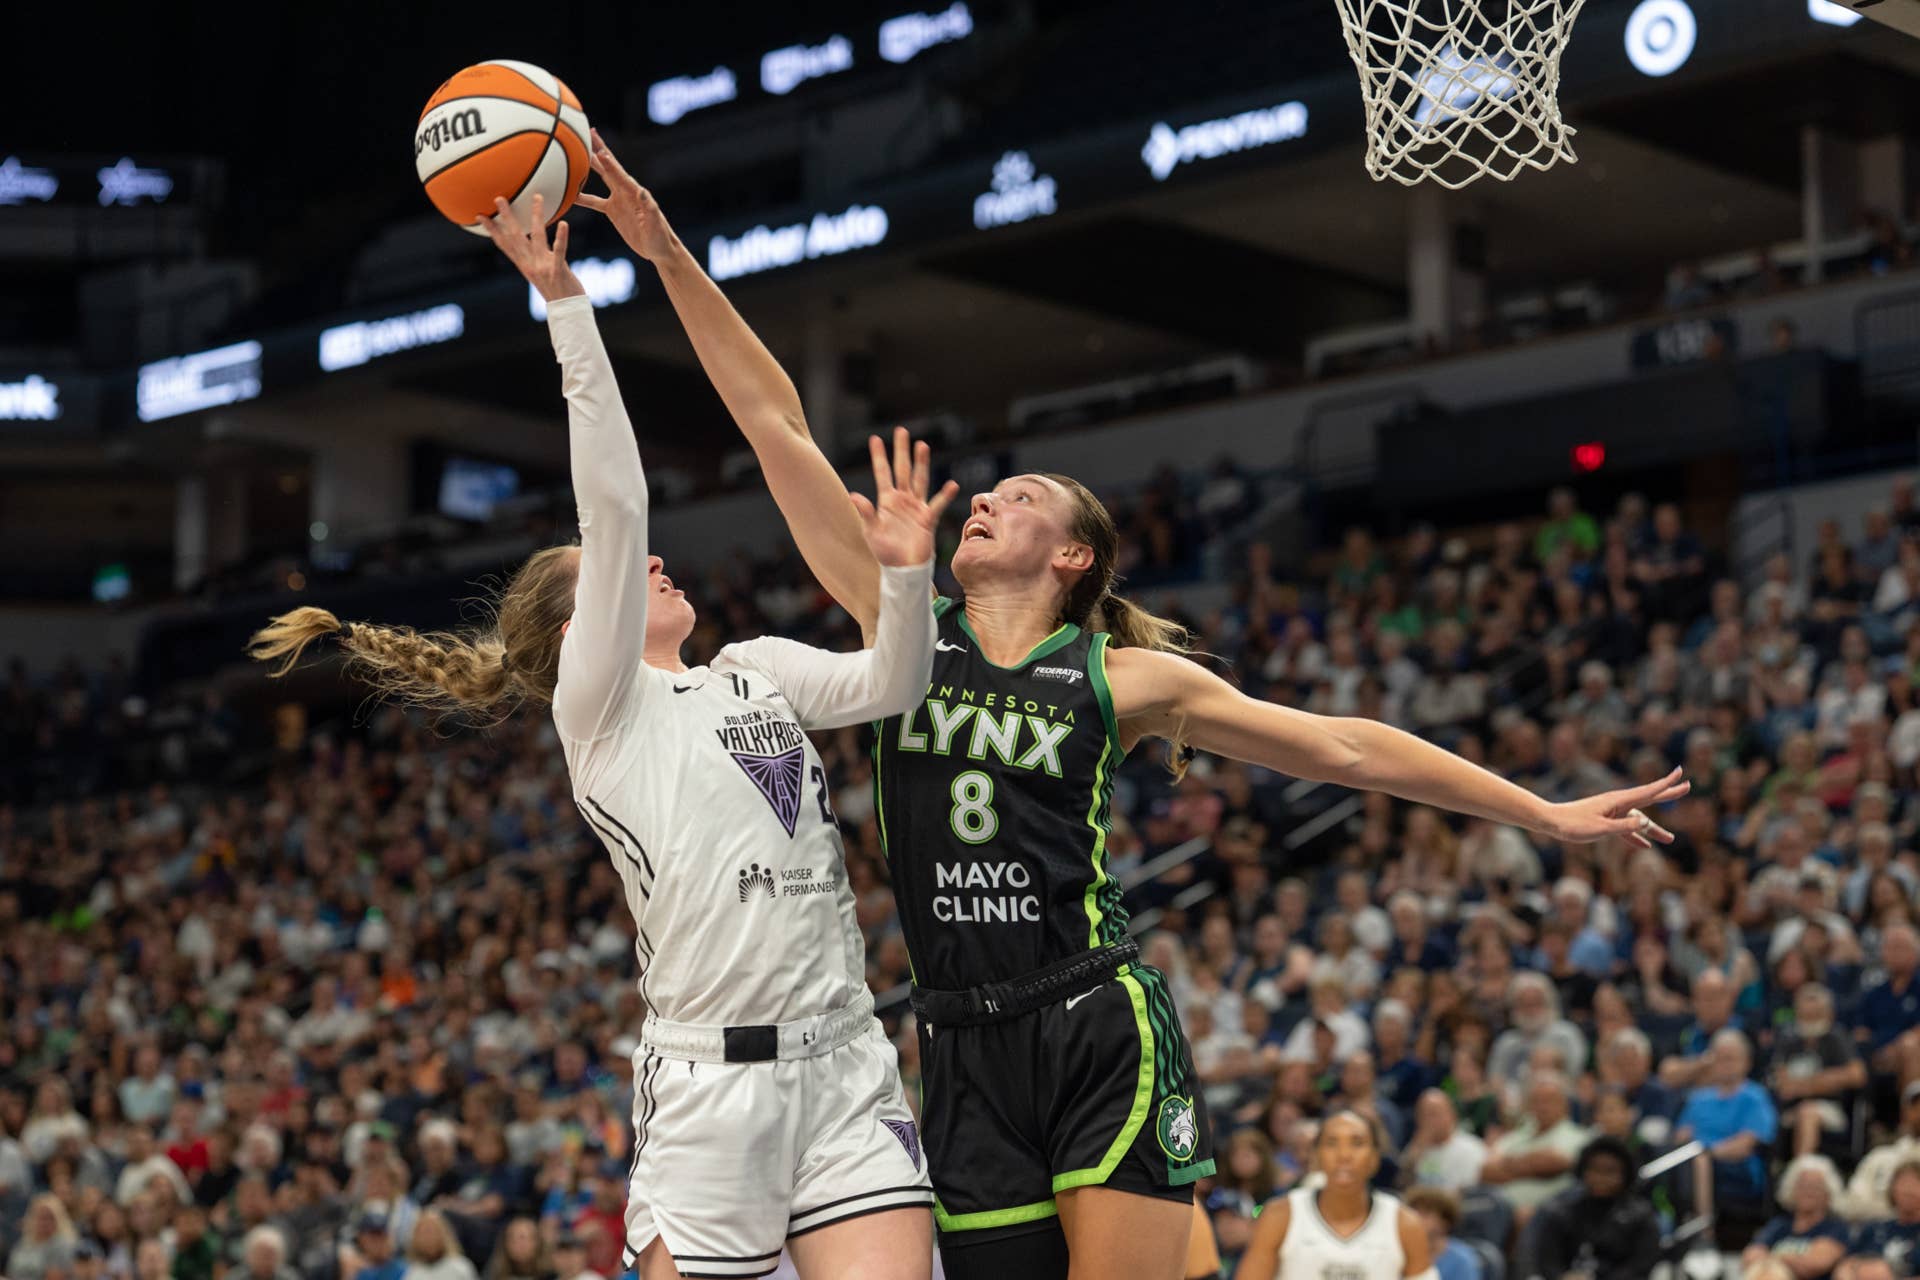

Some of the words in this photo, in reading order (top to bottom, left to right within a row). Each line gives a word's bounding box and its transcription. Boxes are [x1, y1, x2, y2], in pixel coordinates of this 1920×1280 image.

[806, 204, 888, 258] Auto
[724, 710, 762, 726] GOLDEN
[927, 682, 1075, 724] INNESOTA
[715, 721, 803, 755] VALKYRIES
[898, 698, 1074, 779] LYNX
[949, 769, 998, 845] 8
[781, 868, 813, 882] KAISER
[935, 862, 1030, 889] MAYO
[932, 895, 1040, 923] CLINIC
